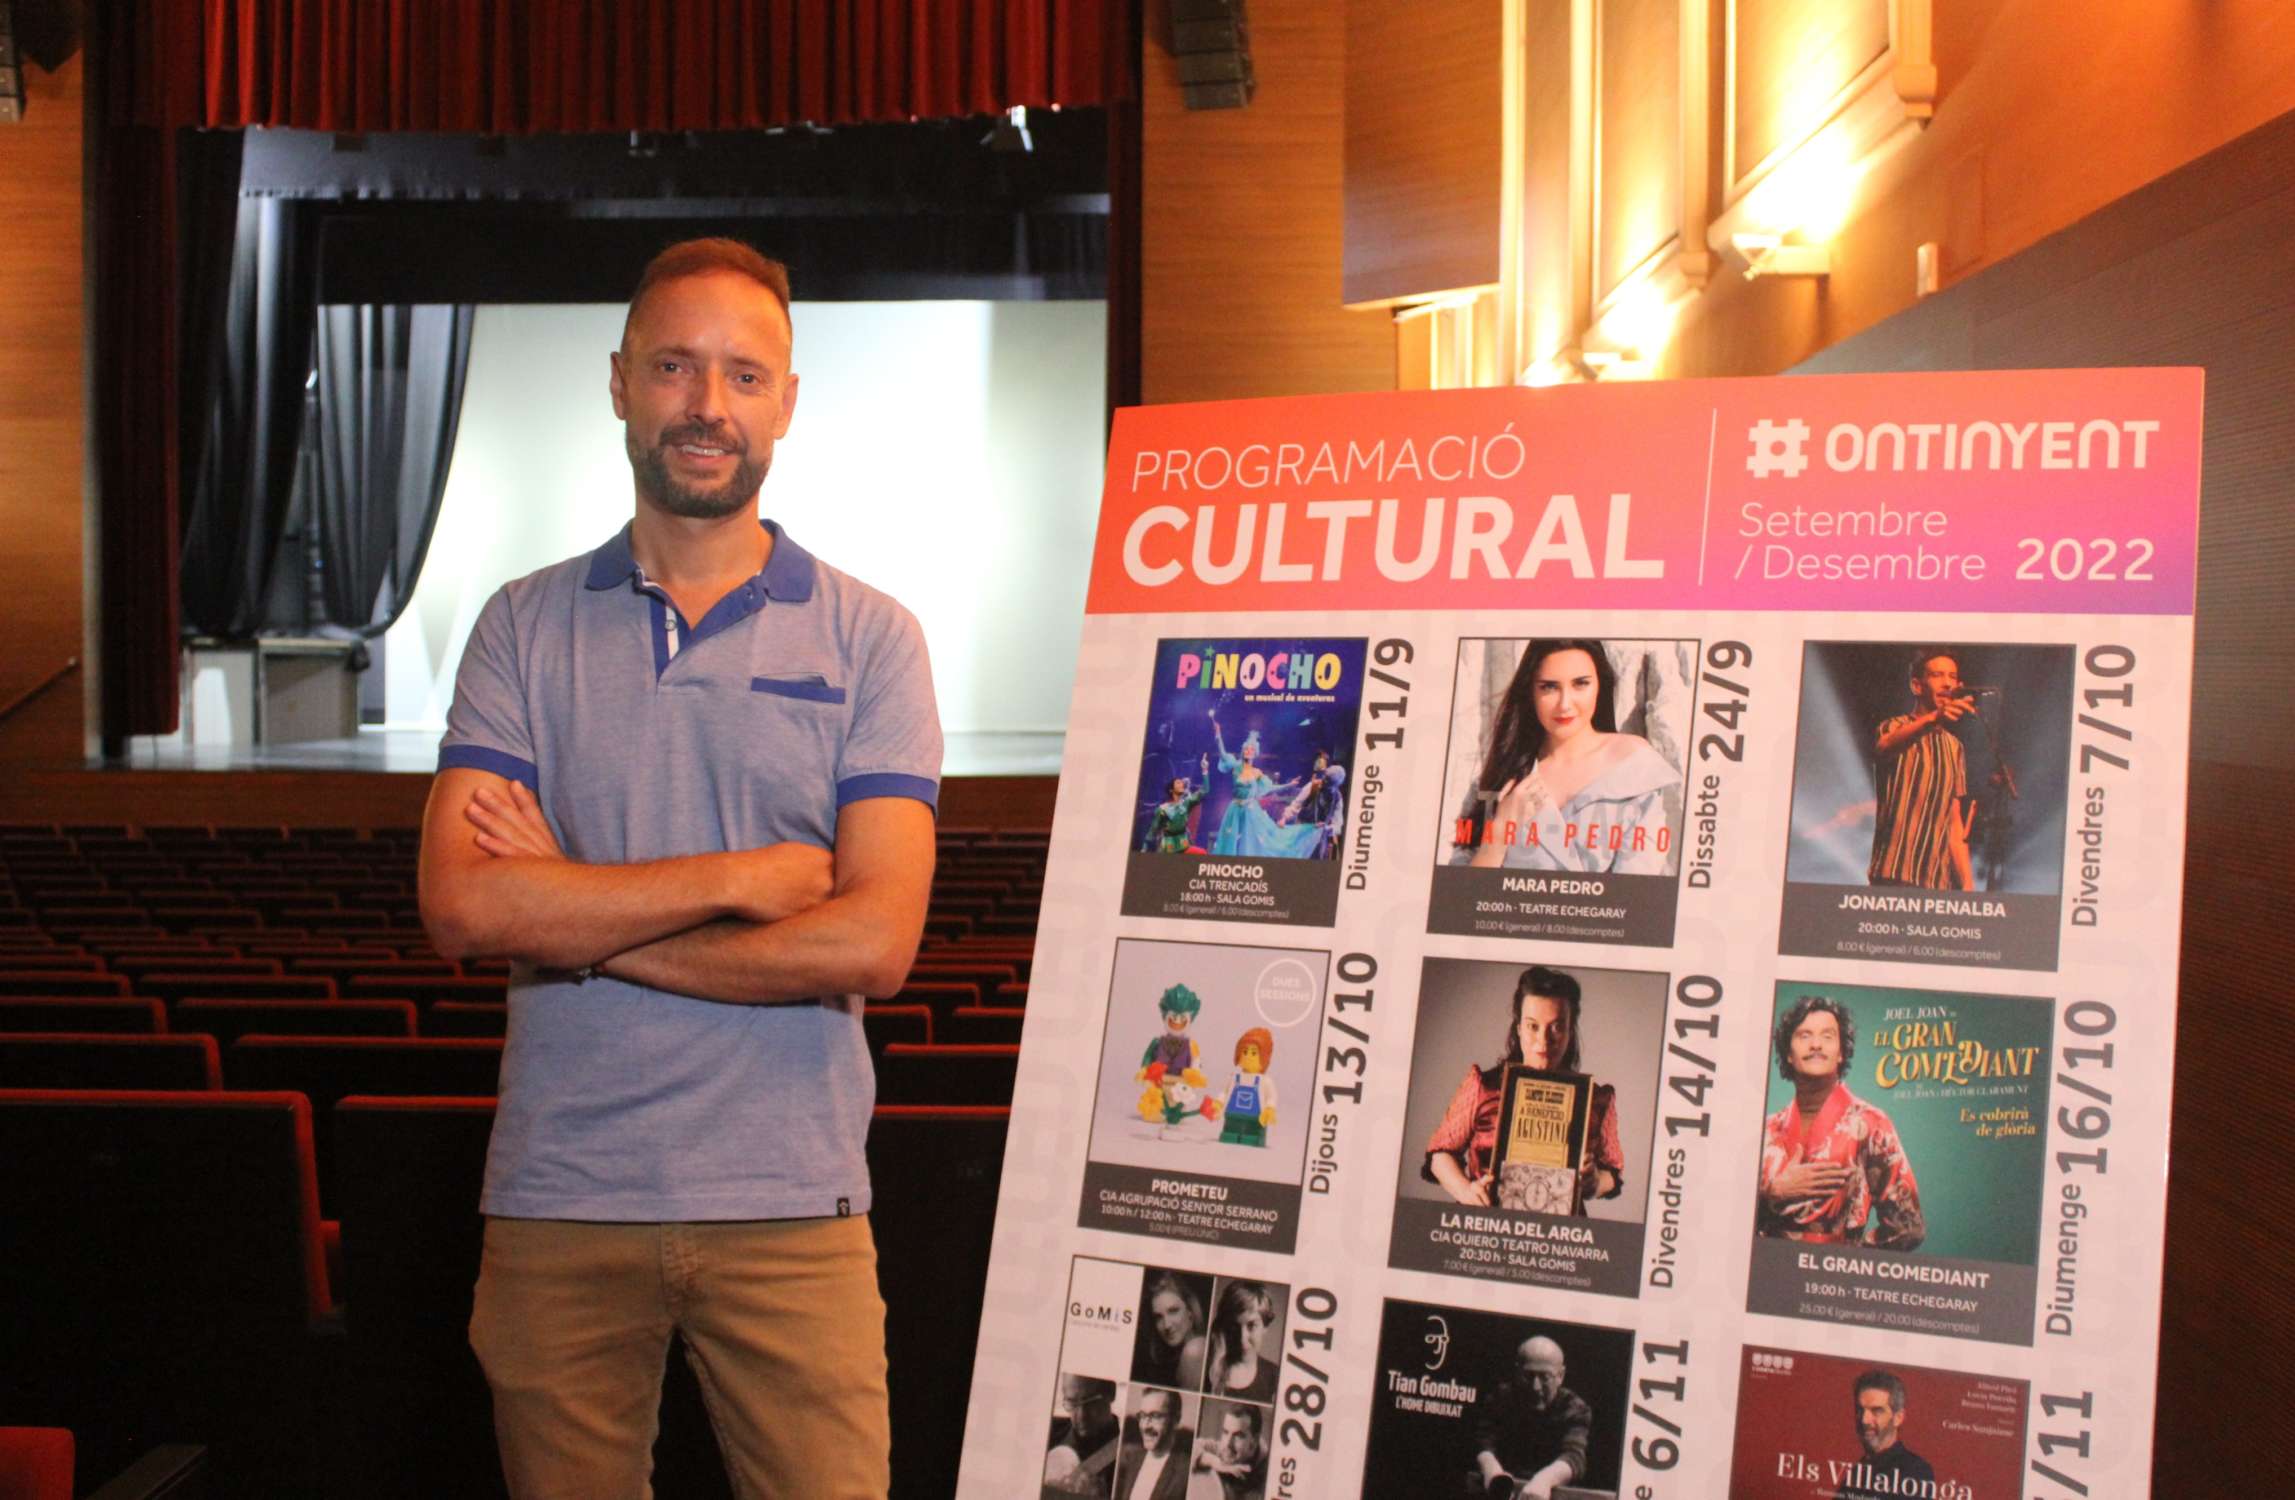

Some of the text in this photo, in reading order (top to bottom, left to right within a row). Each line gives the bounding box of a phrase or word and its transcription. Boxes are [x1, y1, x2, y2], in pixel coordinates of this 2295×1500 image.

[1131, 422, 1526, 493] PROGRAMACIÓ
[1738, 502, 1948, 537] Setembre
[1122, 493, 1665, 588] CULTURAL
[2015, 538, 2154, 581] 2022
[1346, 638, 1414, 890] Diumenge 11/9
[1687, 640, 1753, 889] Dissabte 24/9
[2071, 644, 2136, 926] Divendres 7/10
[1454, 818, 1672, 852] MARA PEDRO
[1189, 879, 1269, 893] CIA TRENCADÍS
[1198, 863, 1264, 878] PINOCHO
[1502, 877, 1604, 896] MARA PEDRO
[1216, 894, 1240, 904] SALA
[1242, 895, 1274, 906] GOMIS
[1476, 901, 1504, 912] 20:00
[1519, 903, 1559, 916] TEATRE
[1560, 906, 1627, 919] ECHEGARAY
[1838, 894, 2006, 918] JONATAN PENALBA
[1858, 922, 1890, 934] 20:00
[1906, 924, 1938, 937] SALA
[1940, 927, 1982, 940] GOMIS
[1884, 1007, 1914, 1021] JOEL
[1916, 1006, 1947, 1020] JOAN
[1892, 1021, 1957, 1050] GRAN
[1309, 952, 1378, 1194] Dijous 13/10
[1875, 1040, 2040, 1089] COMEDIANT
[1649, 975, 1723, 1289] Divendres 14/10
[1976, 1124, 1992, 1137] de
[2045, 1000, 2117, 1337] Diumenge 16/10
[1100, 1189, 1278, 1222] CIA AGRUPACIÓ SENYOR SERRANO
[1151, 1178, 1228, 1201] PROMETEU
[1178, 1213, 1213, 1228] TEATRE
[1214, 1217, 1274, 1235] ECHEGARAY
[1440, 1212, 1594, 1244] LA REINA DEL ARGA
[1430, 1229, 1609, 1262] CIA QUIERO TEATRO NAVARRA
[1459, 1247, 1492, 1262] 20:30
[1508, 1254, 1537, 1268] SALA
[1538, 1257, 1576, 1272] GOMIS
[1798, 1253, 1990, 1289] EL GRAN COMEDIANT
[1804, 1282, 1836, 1296] 19:00
[1853, 1287, 1899, 1305] TEATRE
[1902, 1293, 1978, 1313] ECHEGARAY
[1280, 1287, 1338, 1452] 28/10
[1388, 1370, 1476, 1403] Tian Gombau
[1632, 1340, 1689, 1471] 6/11
[2031, 1391, 2093, 1500] /11
[1776, 1452, 1974, 1500] Els Villalonga
